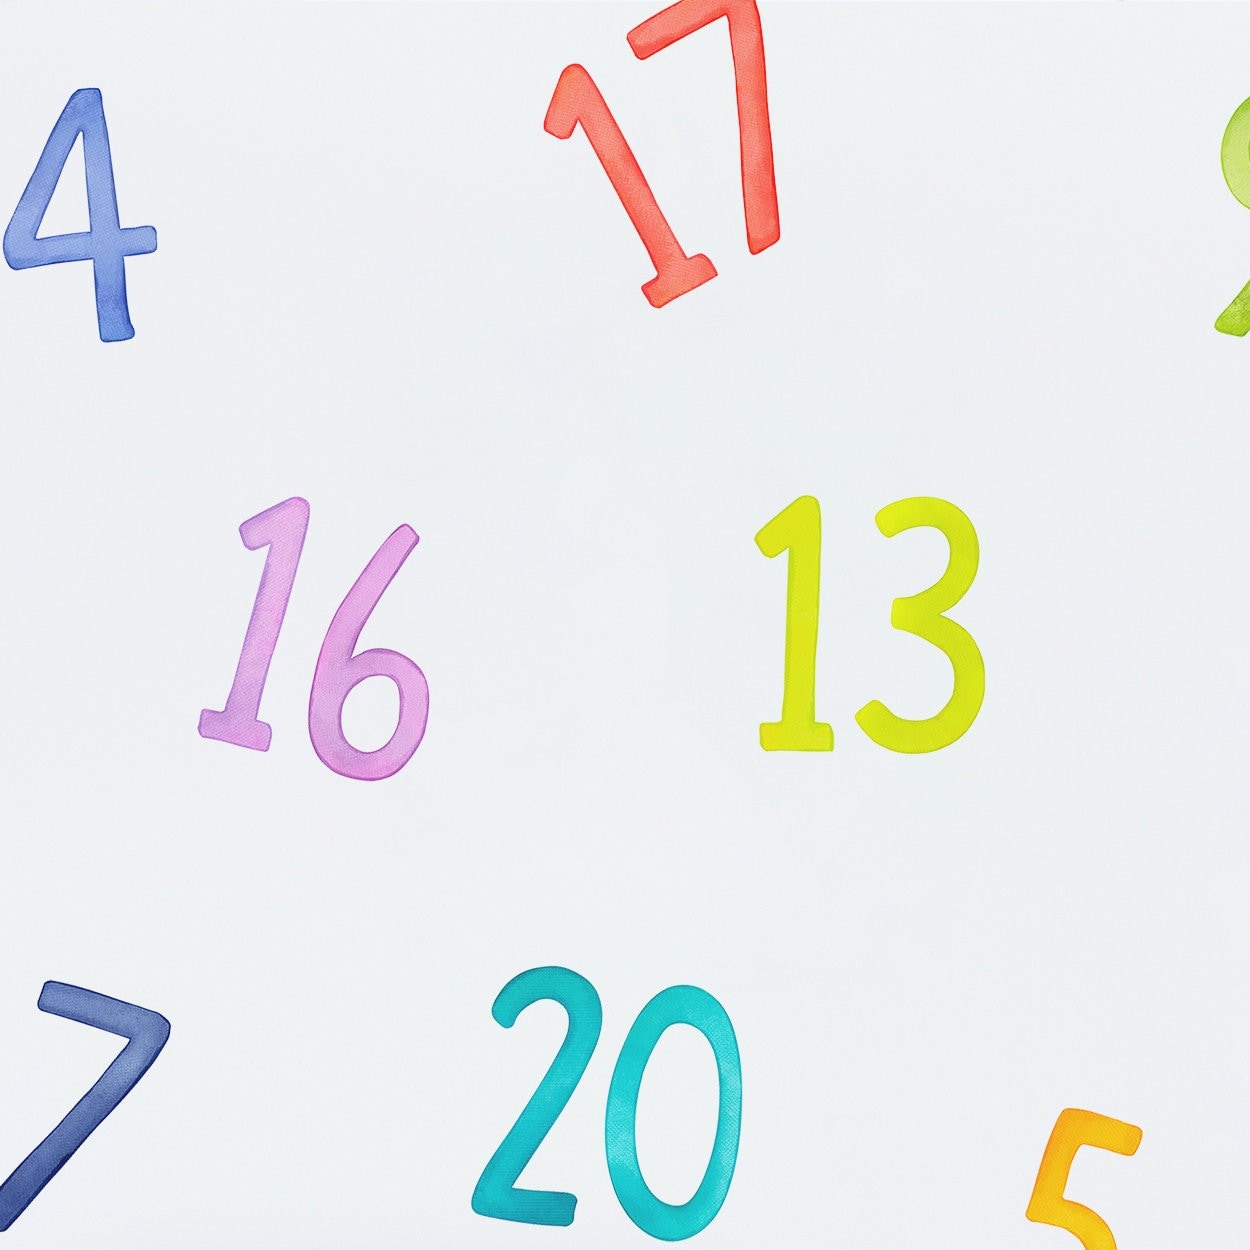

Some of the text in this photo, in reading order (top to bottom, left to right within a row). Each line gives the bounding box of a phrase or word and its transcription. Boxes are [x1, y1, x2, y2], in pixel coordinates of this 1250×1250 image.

[3, 88, 158, 343] 4
[543, 0, 782, 309] 17
[198, 496, 430, 782] 16
[754, 495, 987, 755] 13
[0, 980, 172, 1233] 7
[471, 966, 744, 1242] 20
